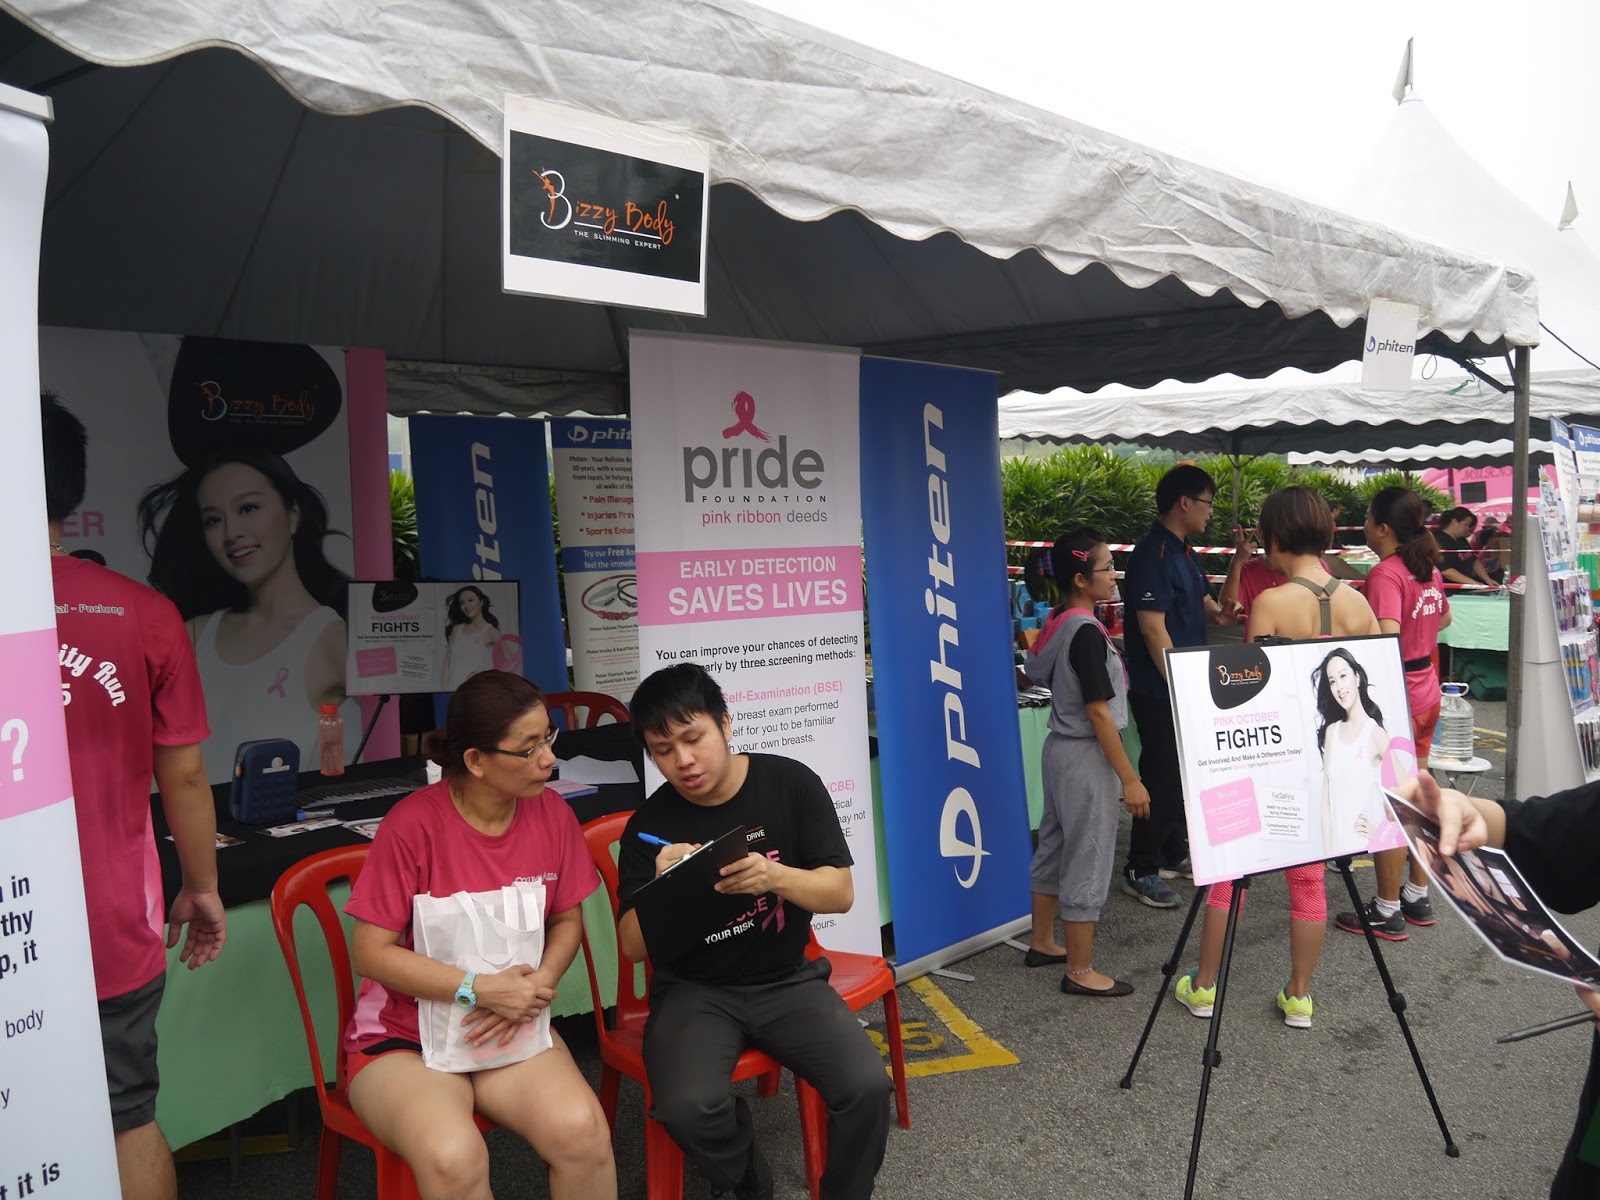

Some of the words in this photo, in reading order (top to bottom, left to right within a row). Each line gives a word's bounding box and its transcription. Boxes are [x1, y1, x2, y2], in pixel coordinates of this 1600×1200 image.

[533, 168, 617, 234] Bizzy
[625, 201, 675, 245] Body
[574, 230, 588, 238] THE
[593, 233, 630, 245] SLIMMING
[635, 240, 662, 250] EXPERT
[1377, 340, 1413, 354] phiten
[272, 390, 315, 421] Body
[591, 428, 632, 444] phit
[683, 435, 825, 503] pride
[589, 495, 606, 504] Pain
[702, 495, 827, 503] FOUNDATION
[471, 442, 502, 580] iten
[587, 512, 617, 521] Injuries
[702, 510, 732, 527] pink
[736, 510, 781, 524] ribbon
[787, 508, 828, 523] deeds
[585, 526, 613, 537] Sports
[583, 549, 594, 558] Try
[607, 548, 625, 556] Free
[680, 560, 736, 579] EARLY
[742, 556, 836, 576] DETECTION
[923, 402, 982, 769] phiten
[668, 583, 764, 616] SAVES
[772, 579, 847, 609] LIVES
[79, 603, 125, 617] Puchong
[371, 622, 420, 633] FIGHTS
[656, 649, 678, 661] You
[680, 649, 698, 659] can
[700, 644, 740, 658] improve
[742, 643, 765, 655] your
[767, 639, 805, 651] chances
[808, 637, 818, 647] of
[819, 634, 858, 648] detecting
[725, 660, 738, 672] by
[740, 658, 766, 669] three
[768, 654, 813, 668] screening
[815, 649, 856, 662] methods:
[93, 661, 126, 707] Run
[723, 684, 811, 704] Self-Examination
[813, 680, 843, 696] (BSE)
[737, 708, 766, 721] breast
[768, 706, 792, 717] exam
[794, 700, 839, 716] performed
[1213, 716, 1235, 728] PINK
[1236, 711, 1280, 724] OCTOBER
[746, 726, 759, 735] for
[761, 724, 778, 736] you
[780, 723, 789, 731] to
[791, 720, 802, 729] be
[804, 716, 836, 728] familiar
[737, 742, 758, 753] your
[760, 738, 780, 749] own
[782, 733, 816, 747] breasts.
[1215, 724, 1282, 751] FIGHTS
[1208, 757, 1230, 766] Involved
[1242, 753, 1256, 761] Make
[1261, 750, 1286, 758] Difference
[826, 779, 855, 793] (CBE)
[833, 797, 852, 810] dical
[853, 811, 866, 821] not
[746, 829, 765, 842] DRIVE
[842, 828, 854, 838] SE.
[11, 875, 31, 899] in
[704, 929, 731, 945] YOUR
[733, 919, 755, 936] RISK
[24, 939, 38, 964] it
[5, 1009, 44, 1039] body
[17, 1172, 34, 1198] it
[42, 1162, 61, 1186] is
